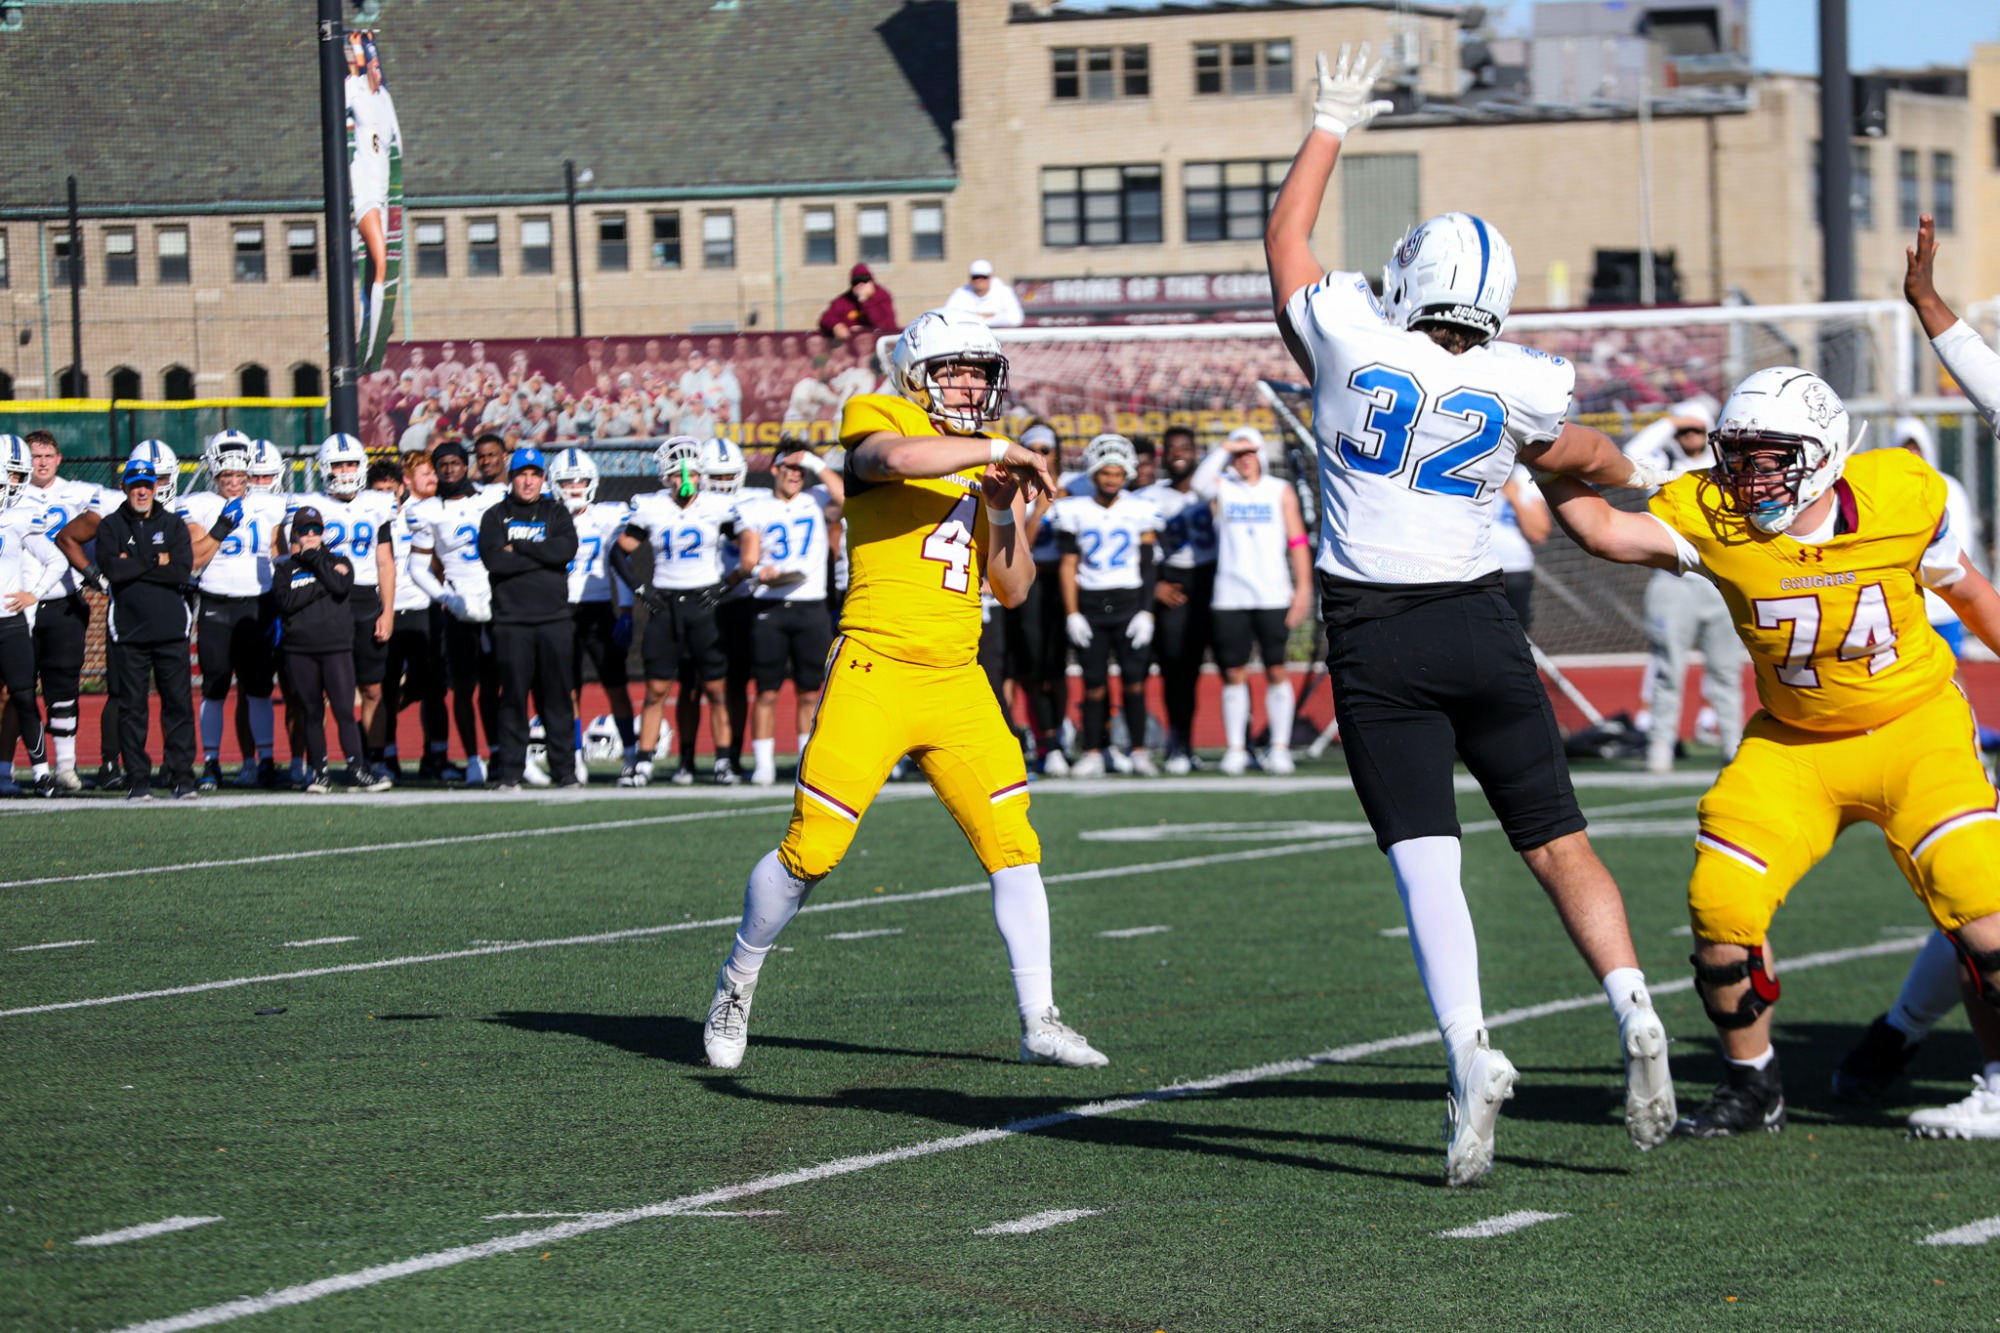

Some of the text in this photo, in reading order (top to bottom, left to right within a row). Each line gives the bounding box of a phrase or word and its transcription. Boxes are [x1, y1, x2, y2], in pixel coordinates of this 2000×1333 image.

[1336, 362, 1509, 499] 32
[322, 521, 374, 558] 28
[660, 526, 703, 560] 12
[765, 516, 815, 561] 37
[921, 492, 979, 594] 4
[1081, 529, 1131, 568] 22
[1780, 571, 1857, 591] COUGARS
[1752, 581, 1899, 688] 74
